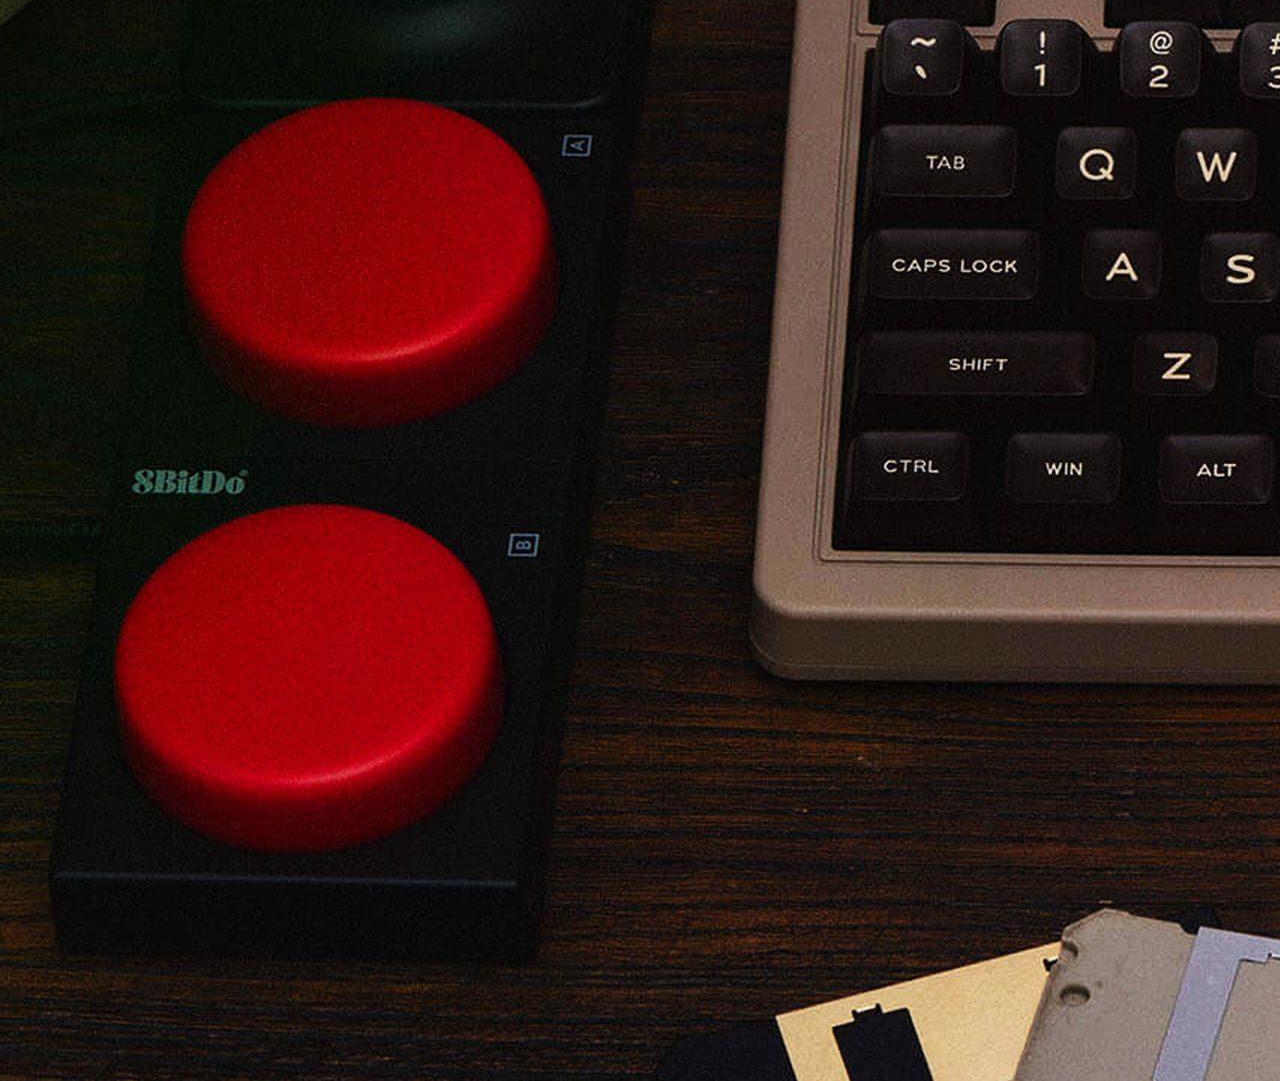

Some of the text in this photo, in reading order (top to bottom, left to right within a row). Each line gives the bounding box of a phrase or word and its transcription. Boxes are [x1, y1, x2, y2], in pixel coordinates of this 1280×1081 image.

[1039, 31, 1046, 55] !
[1149, 30, 1173, 55] @
[1034, 63, 1046, 87] 1
[1149, 64, 1169, 88] 2
[925, 155, 965, 170] TAB
[1079, 148, 1114, 181] Q
[1196, 151, 1237, 182] W
[891, 258, 951, 273] CAPS
[960, 259, 1018, 273] LOCK
[1105, 252, 1138, 281] A
[1226, 254, 1256, 284] S
[948, 358, 1008, 371] SHIFT
[1161, 352, 1192, 380] Z
[883, 459, 939, 474] CTRL
[1045, 462, 1083, 476] WIN
[1196, 463, 1237, 478] ALT
[131, 469, 249, 496] 8BitDo
